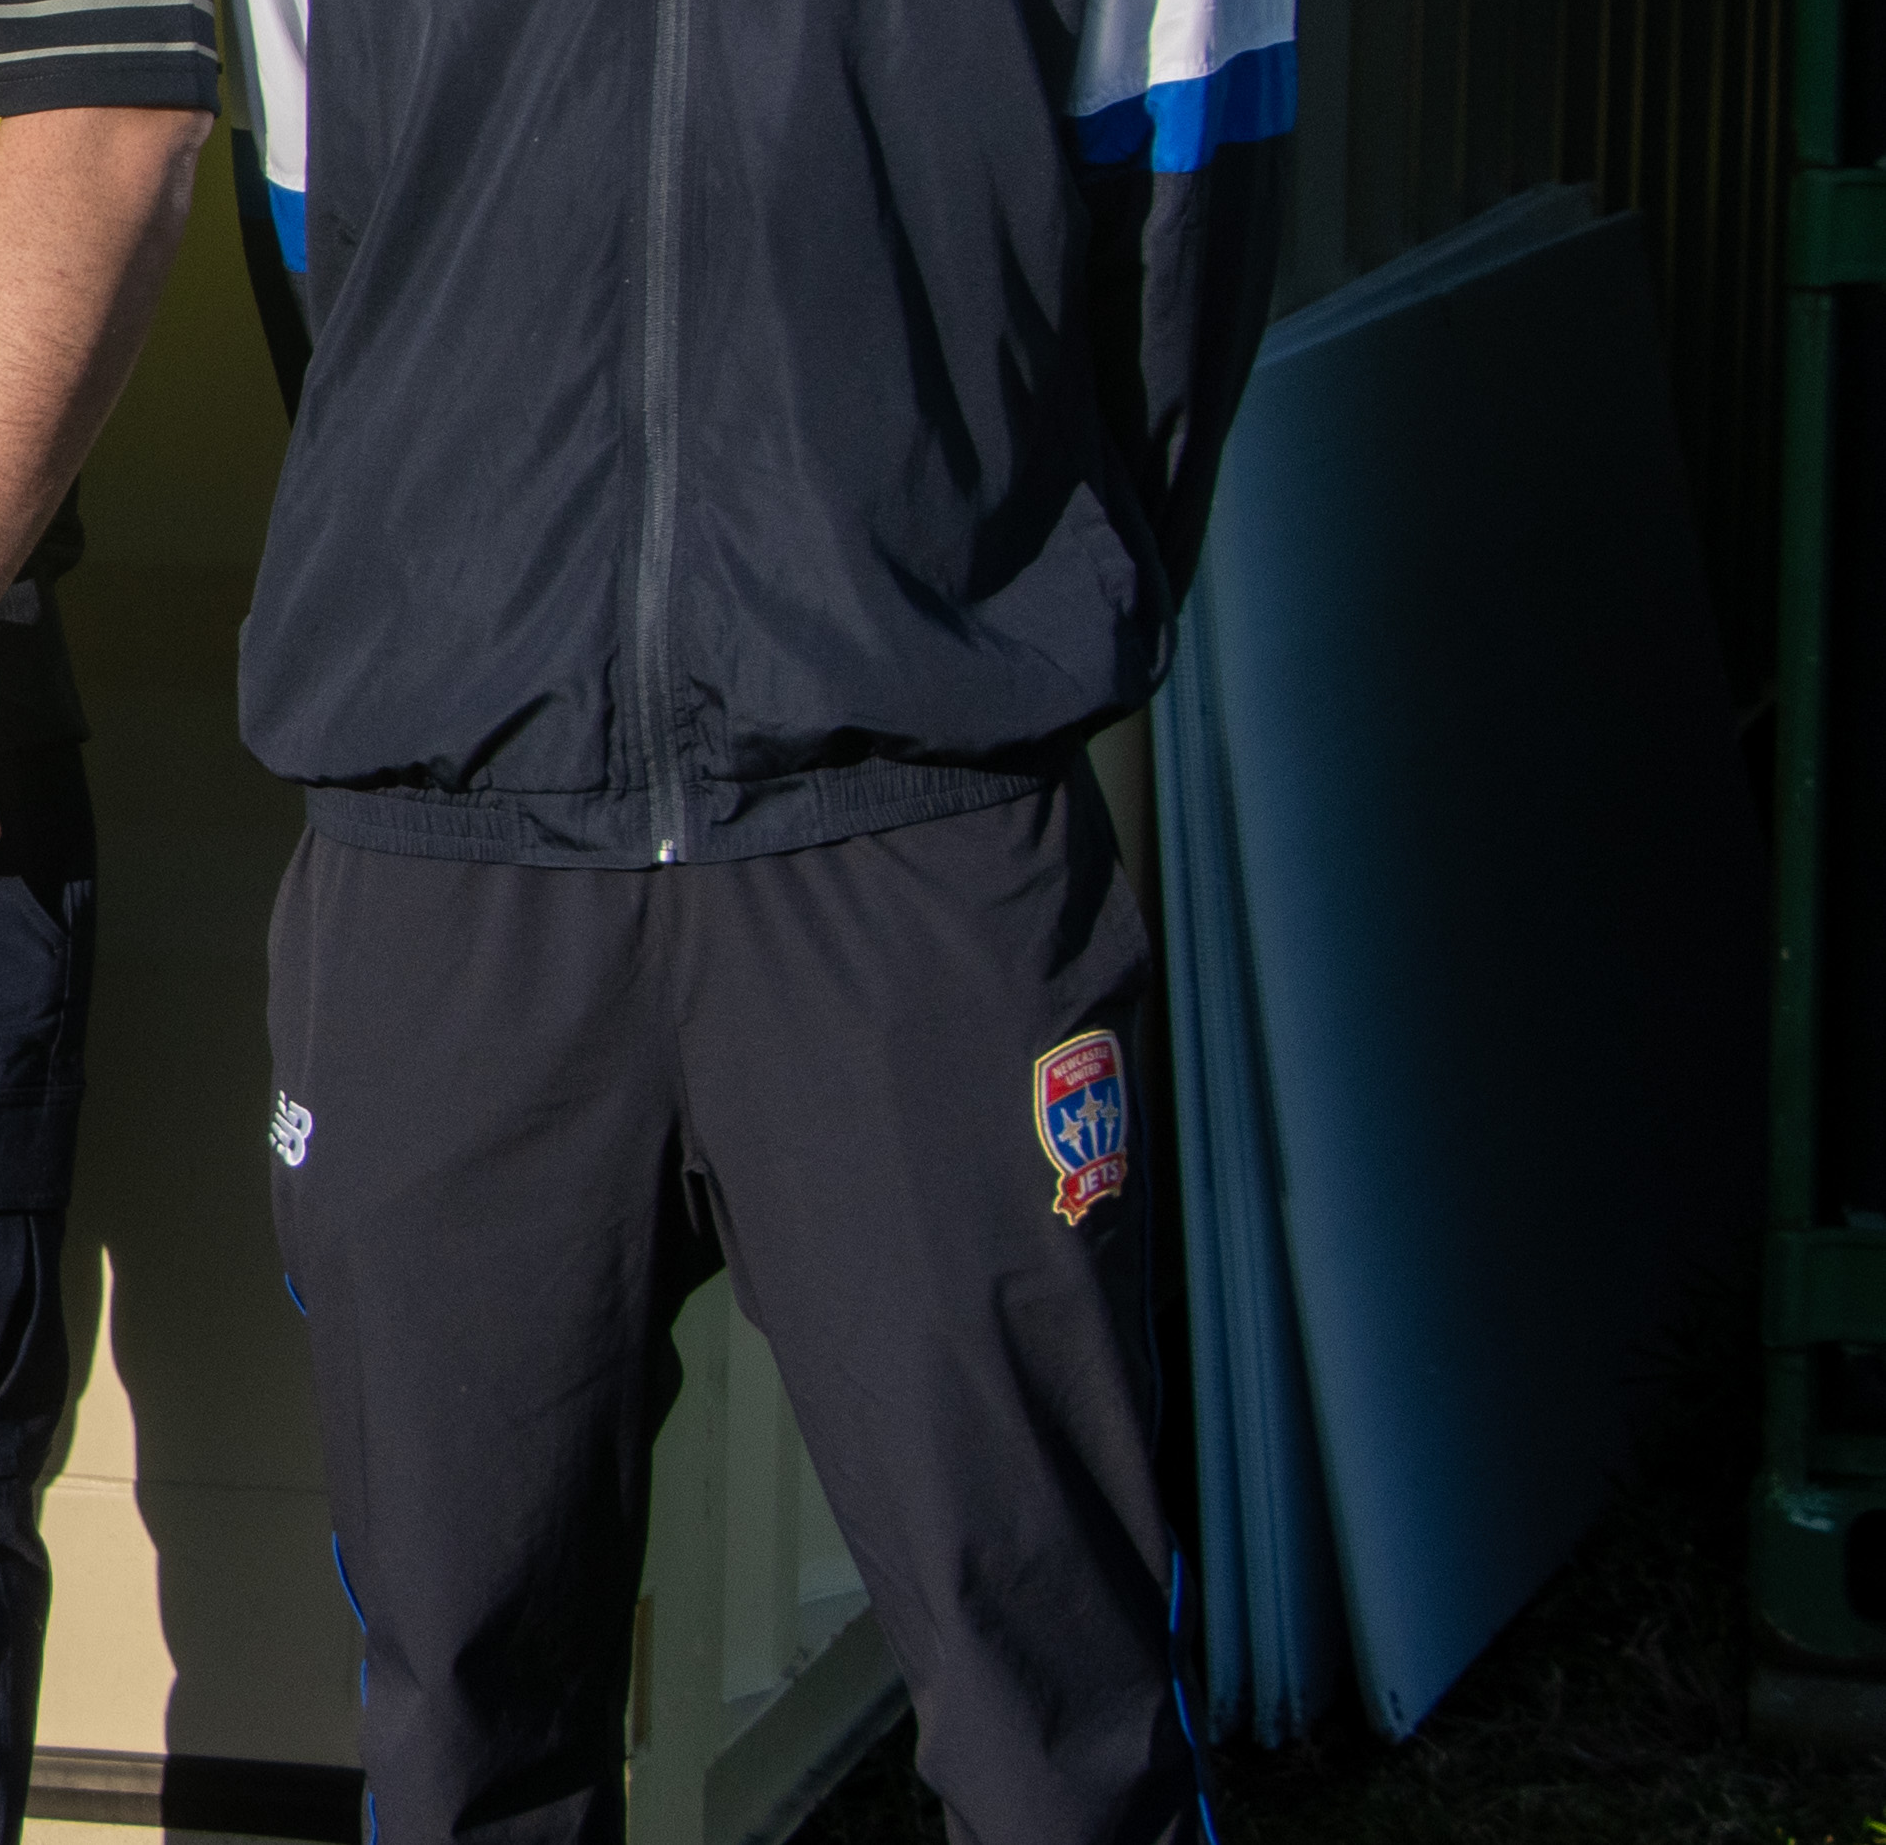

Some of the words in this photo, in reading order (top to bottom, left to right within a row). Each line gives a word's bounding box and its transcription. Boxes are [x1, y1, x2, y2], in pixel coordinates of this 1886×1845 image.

[1052, 1045, 1110, 1079] NEWCASTLE
[1066, 1062, 1102, 1087] UNITED
[1075, 1160, 1119, 1200] JETS
